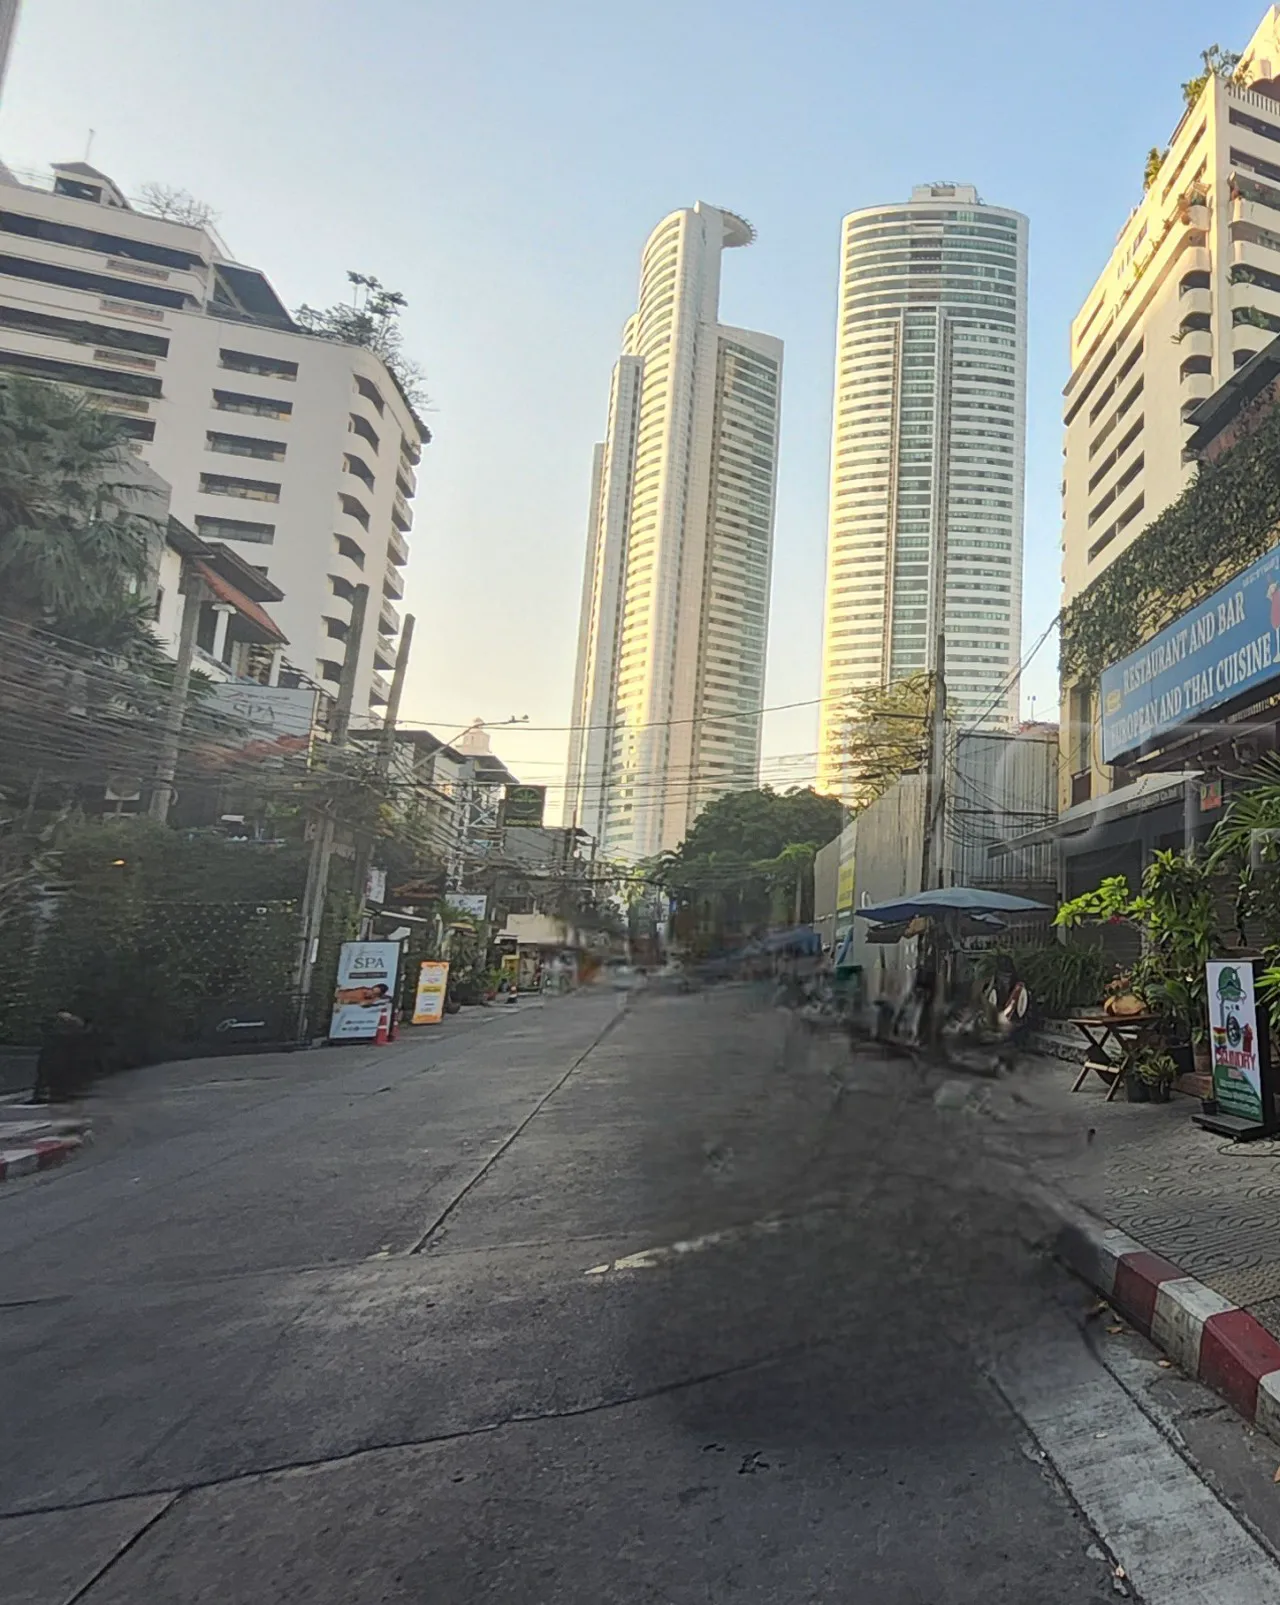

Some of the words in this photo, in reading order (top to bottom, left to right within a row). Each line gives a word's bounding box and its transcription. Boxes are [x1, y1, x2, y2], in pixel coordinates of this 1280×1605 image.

[1110, 697, 1159, 748] EUROPEAN
[1159, 685, 1182, 723] AND
[1183, 665, 1214, 710] THAI
[1216, 632, 1272, 694] CUISINE
[1123, 630, 1188, 695] RESTAURANT
[1188, 610, 1215, 655] AND
[1217, 590, 1246, 637] BAR
[353, 957, 385, 969] SPA
